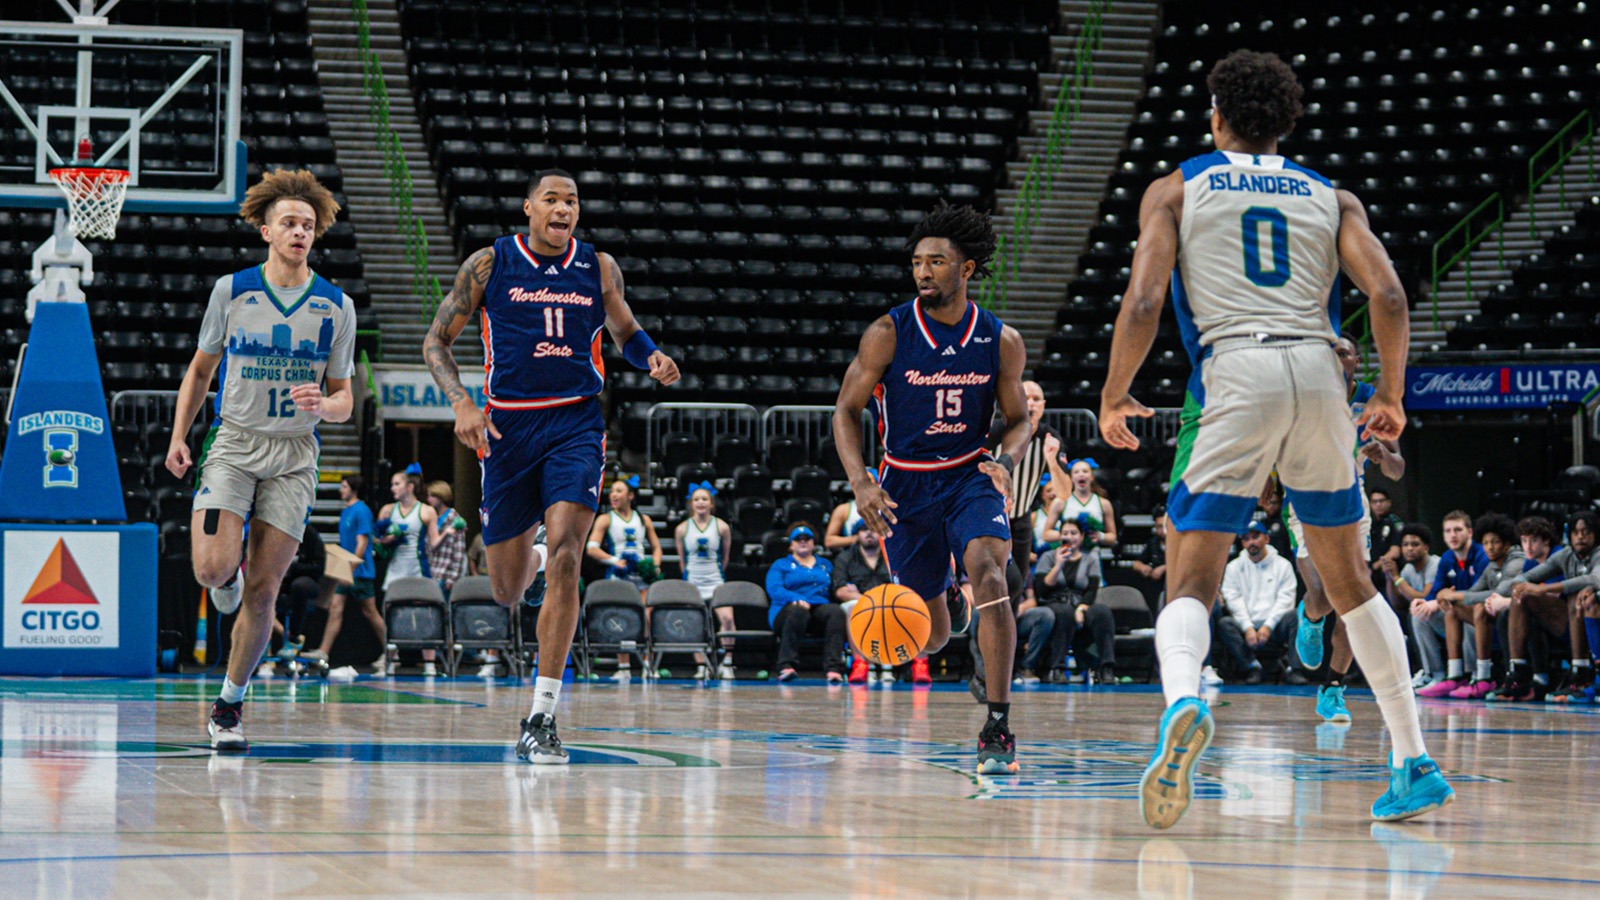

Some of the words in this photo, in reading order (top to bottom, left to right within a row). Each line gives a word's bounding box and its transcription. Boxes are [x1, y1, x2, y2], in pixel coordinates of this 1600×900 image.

[1208, 172, 1312, 197] ISLANDERS
[1241, 205, 1291, 288] 0
[508, 287, 593, 307] Northwestern
[543, 307, 564, 338] 11
[533, 341, 573, 358] State
[256, 356, 288, 367] TEXAS
[291, 357, 311, 368] A&M
[241, 366, 282, 381] CORPUS
[904, 369, 991, 386] Northwestern
[1412, 371, 1495, 395] Michelob
[1516, 369, 1599, 392] ULTRA
[267, 388, 295, 418] 12
[935, 388, 963, 419] 15
[1445, 395, 1498, 405] SUPERIOR
[1503, 394, 1536, 403] LIGHT
[19, 411, 103, 434] ISLANDERS
[925, 421, 967, 435] State
[21, 610, 100, 631] CITGO
[20, 634, 66, 645] FUELING
[68, 634, 101, 645] GOOD
